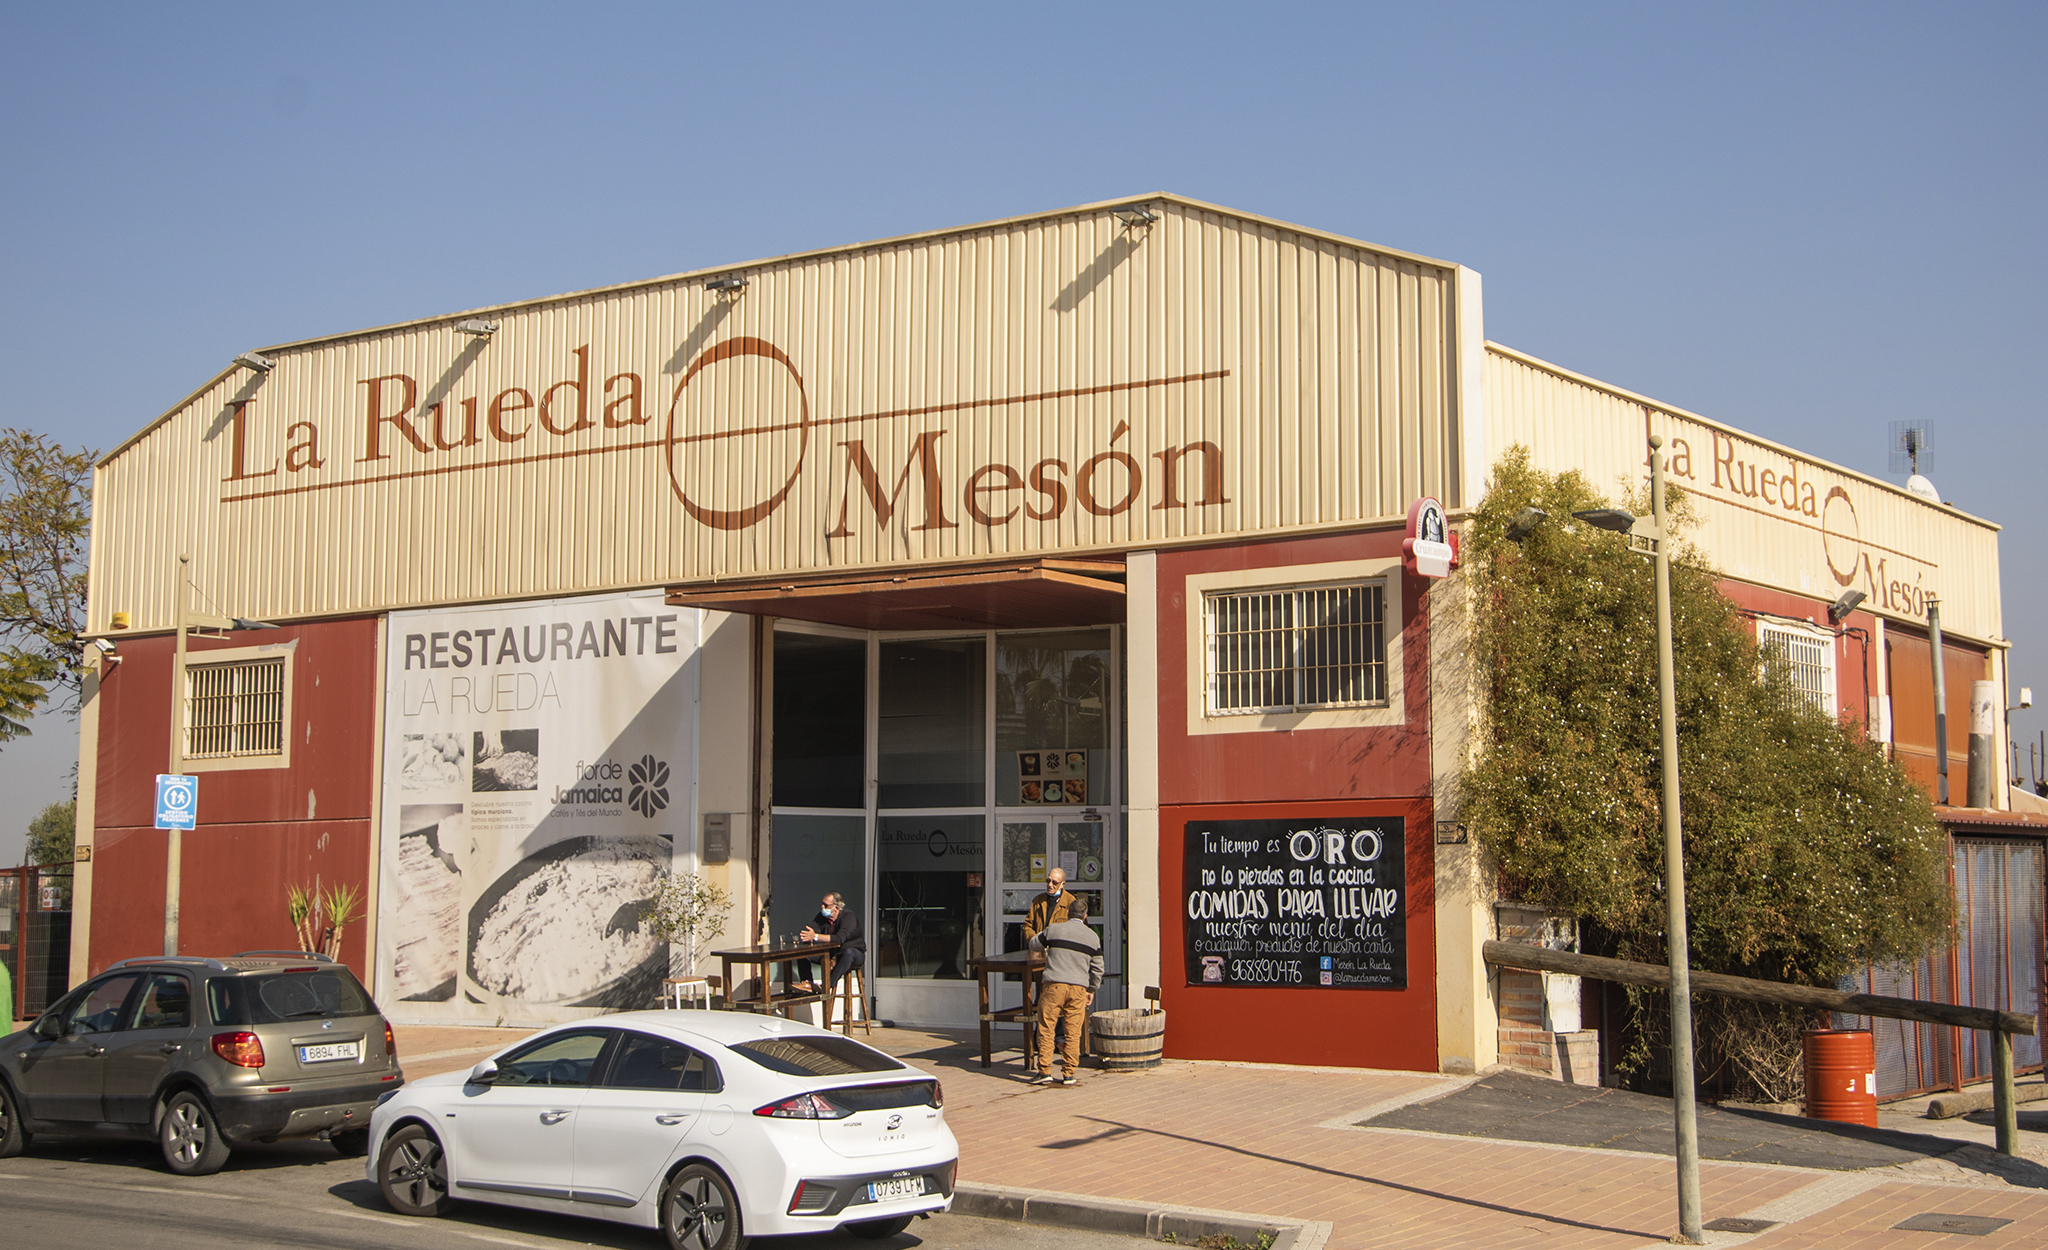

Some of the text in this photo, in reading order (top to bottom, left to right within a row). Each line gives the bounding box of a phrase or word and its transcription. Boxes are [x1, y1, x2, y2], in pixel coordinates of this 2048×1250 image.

[221, 343, 652, 483] La Rueda
[1641, 407, 1819, 519] La Rueda
[826, 419, 1231, 538] Mesón
[404, 614, 678, 670] RESTAURANTE
[403, 671, 561, 717] LA RUEDA
[550, 783, 622, 805] Jamaica
[550, 808, 622, 818] Cafés y Tés del Mundo
[881, 829, 927, 841] La Rueda
[1201, 827, 1384, 865] Tu tiempo es ORO
[949, 844, 983, 855] Mesón
[1201, 865, 1376, 890] no lo pierdas en la cocina
[1188, 887, 1398, 919] COMIDAS PARA LLEVAR
[1206, 916, 1386, 940] nuestro menú del día
[1194, 935, 1394, 960] o cualquier producto de nuestra carta
[1230, 958, 1303, 983] 968890476
[1356, 957, 1368, 970] La
[1369, 957, 1392, 970] Rueda
[309, 1045, 354, 1059] 6894 FHL
[876, 1177, 923, 1197] 0739 LFM
